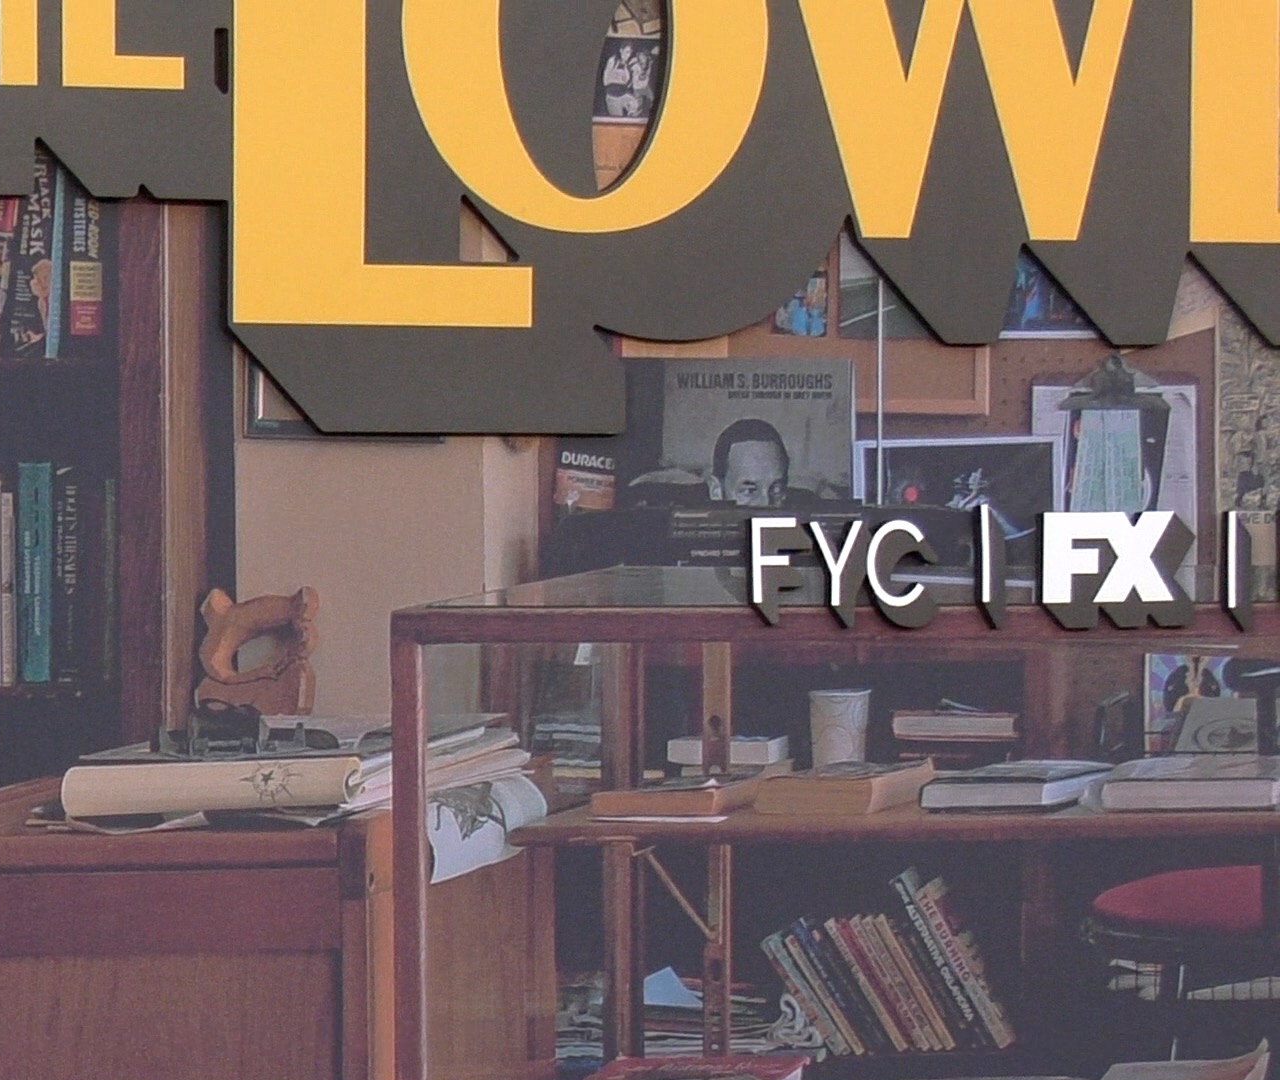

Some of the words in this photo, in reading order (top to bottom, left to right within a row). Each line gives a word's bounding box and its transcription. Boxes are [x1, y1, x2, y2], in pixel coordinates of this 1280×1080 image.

[28, 193, 44, 256] MASK
[677, 373, 736, 389] WILLIAM
[738, 373, 750, 389] S.
[751, 373, 833, 390] BURROUGHS
[560, 451, 615, 471] DURACE
[751, 517, 926, 607] FYC
[1043, 511, 1175, 604] FX
[934, 920, 974, 983] BURNING
